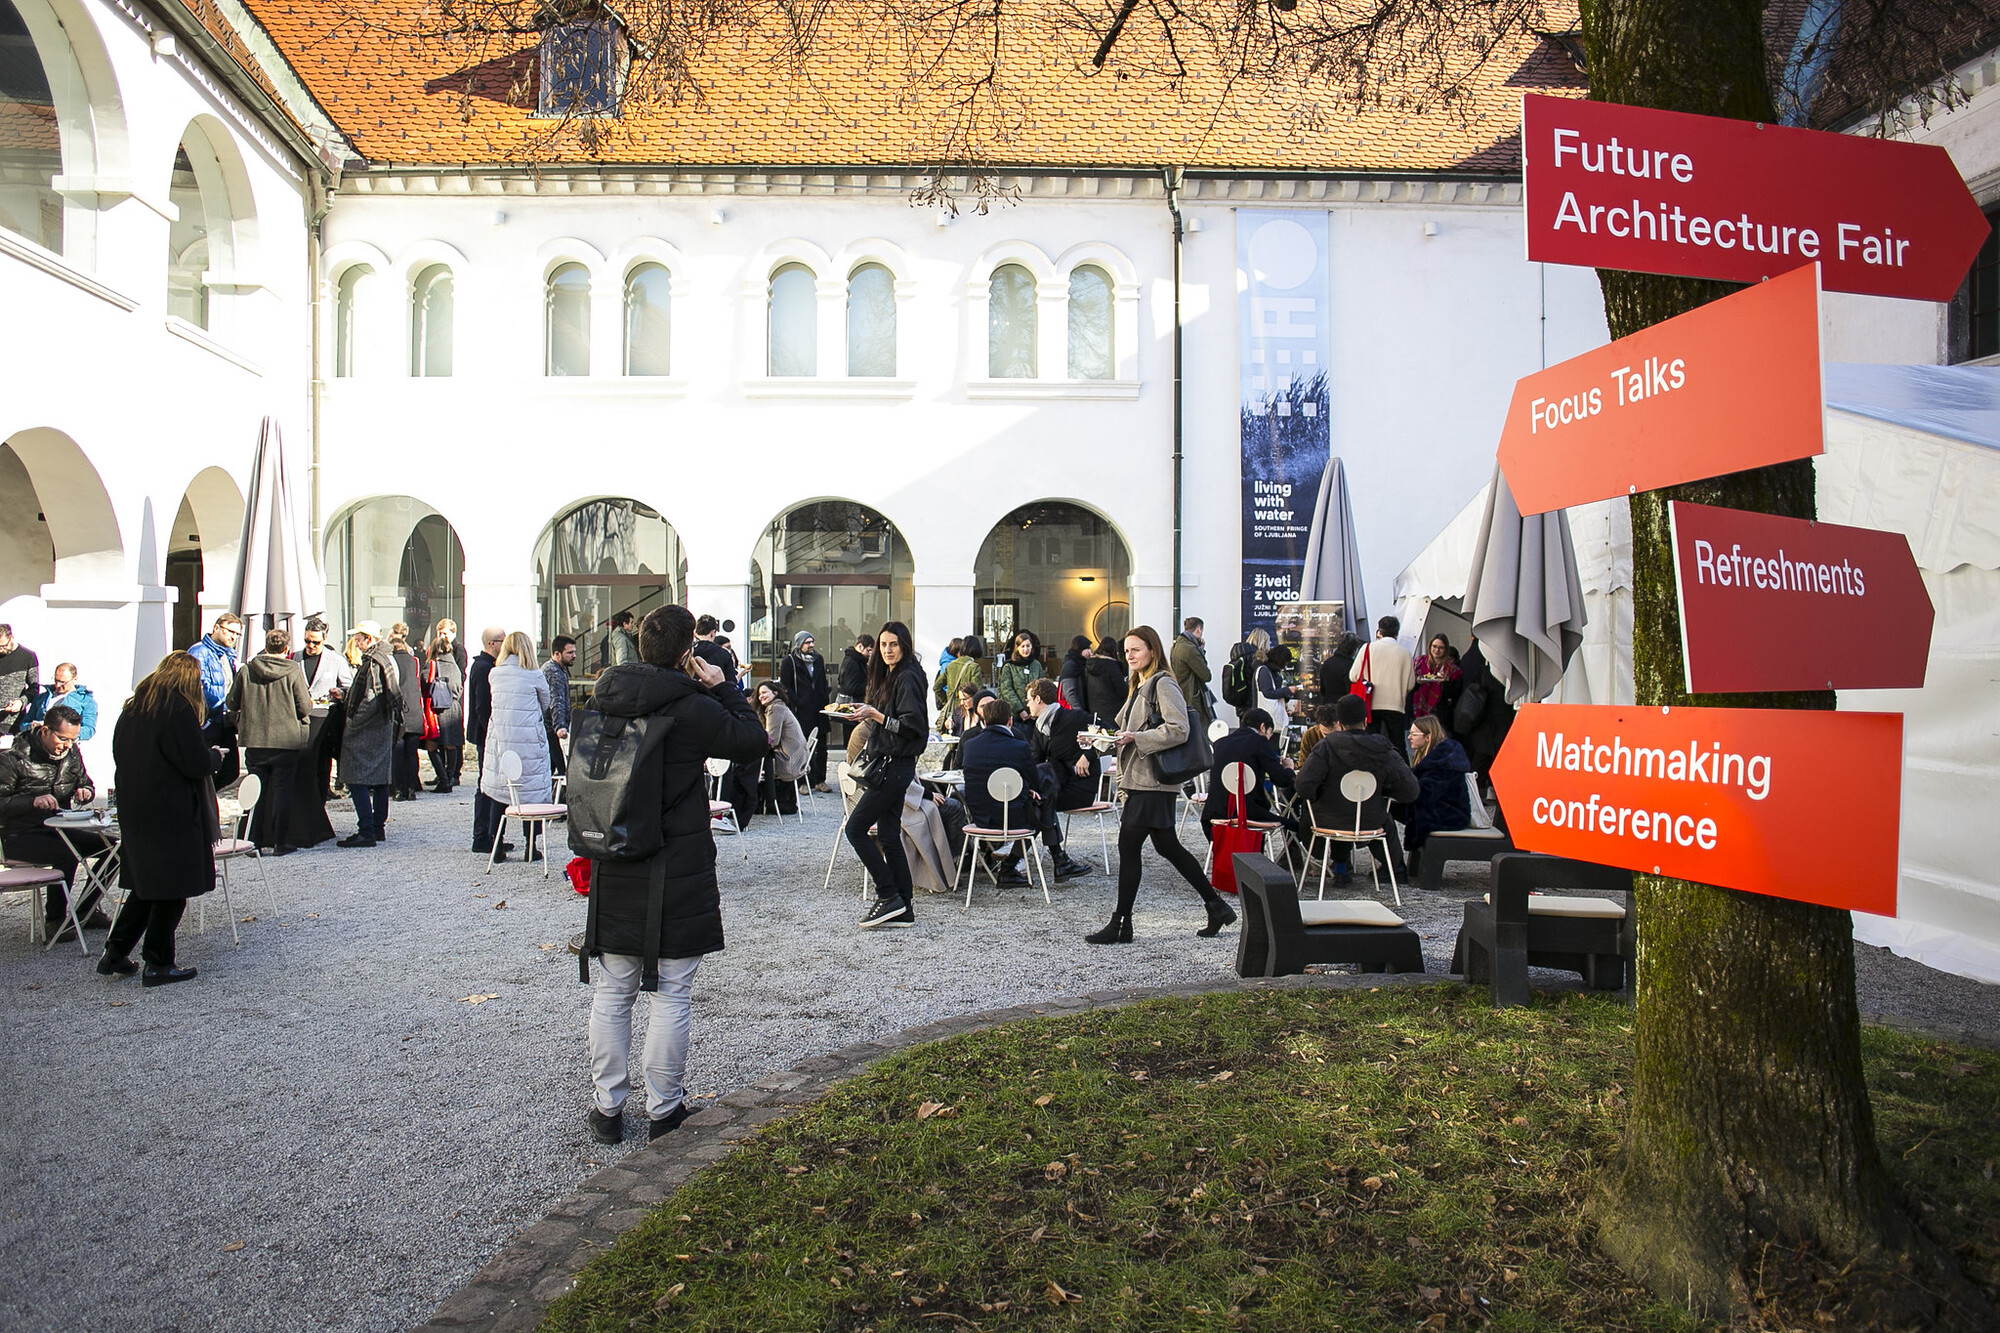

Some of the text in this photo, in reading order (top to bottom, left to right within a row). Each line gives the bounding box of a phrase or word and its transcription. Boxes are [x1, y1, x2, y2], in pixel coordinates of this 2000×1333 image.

[1553, 128, 1693, 182] Future
[1553, 191, 1910, 266] Architecture Fair
[1530, 356, 1686, 434] Focus Talks
[1254, 480, 1292, 497] living
[1254, 494, 1285, 507] with
[1254, 509, 1294, 521] water
[1254, 574, 1291, 588] živeti
[1254, 588, 1300, 600] z vodo
[1694, 540, 1865, 597] Refreshments
[1536, 731, 1772, 801] Matchmaking
[1532, 794, 1718, 850] conference
